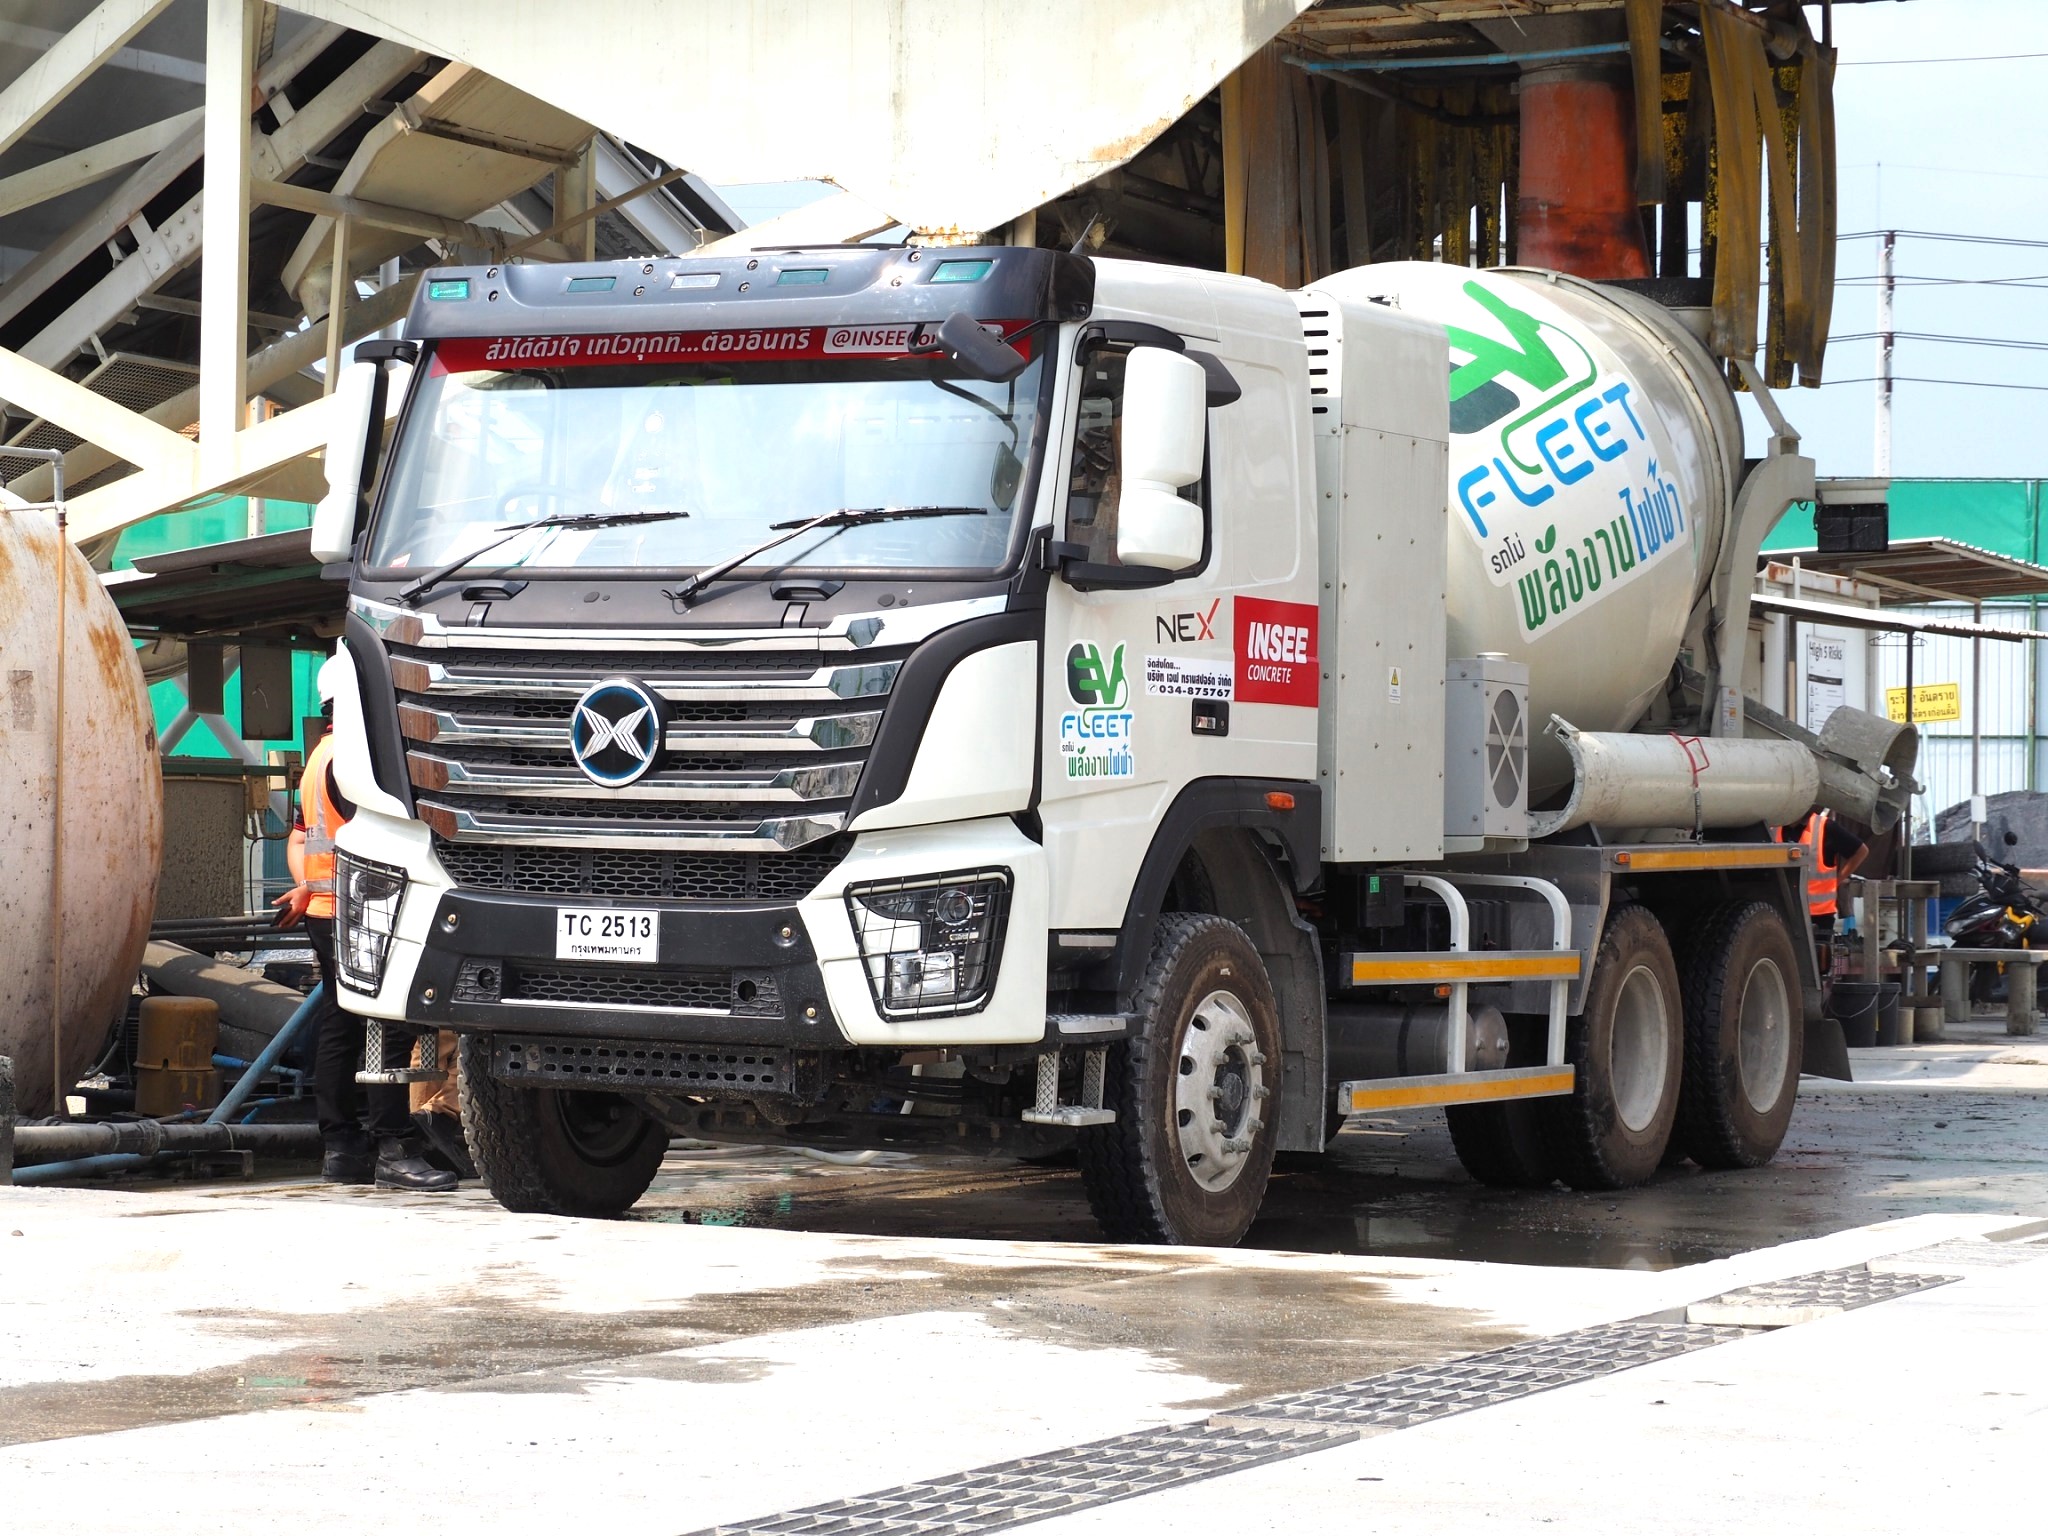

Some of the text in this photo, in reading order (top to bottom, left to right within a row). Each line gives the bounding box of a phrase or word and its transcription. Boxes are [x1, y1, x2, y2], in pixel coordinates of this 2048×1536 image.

[1457, 382, 1645, 539] FLEET
[1491, 532, 1526, 574] รถโม่
[1518, 456, 1685, 631] พลังงานไฟฟ้า
[1156, 598, 1221, 644] NEX
[1247, 621, 1309, 664] INSEE
[1066, 643, 1126, 705] EV
[1159, 684, 1231, 698] 034-875767
[1247, 664, 1292, 684] CONCRETE
[1062, 714, 1133, 739] FLEET
[564, 914, 651, 938] TC 2513
[571, 944, 642, 957] กรุงเทพมหานคร
